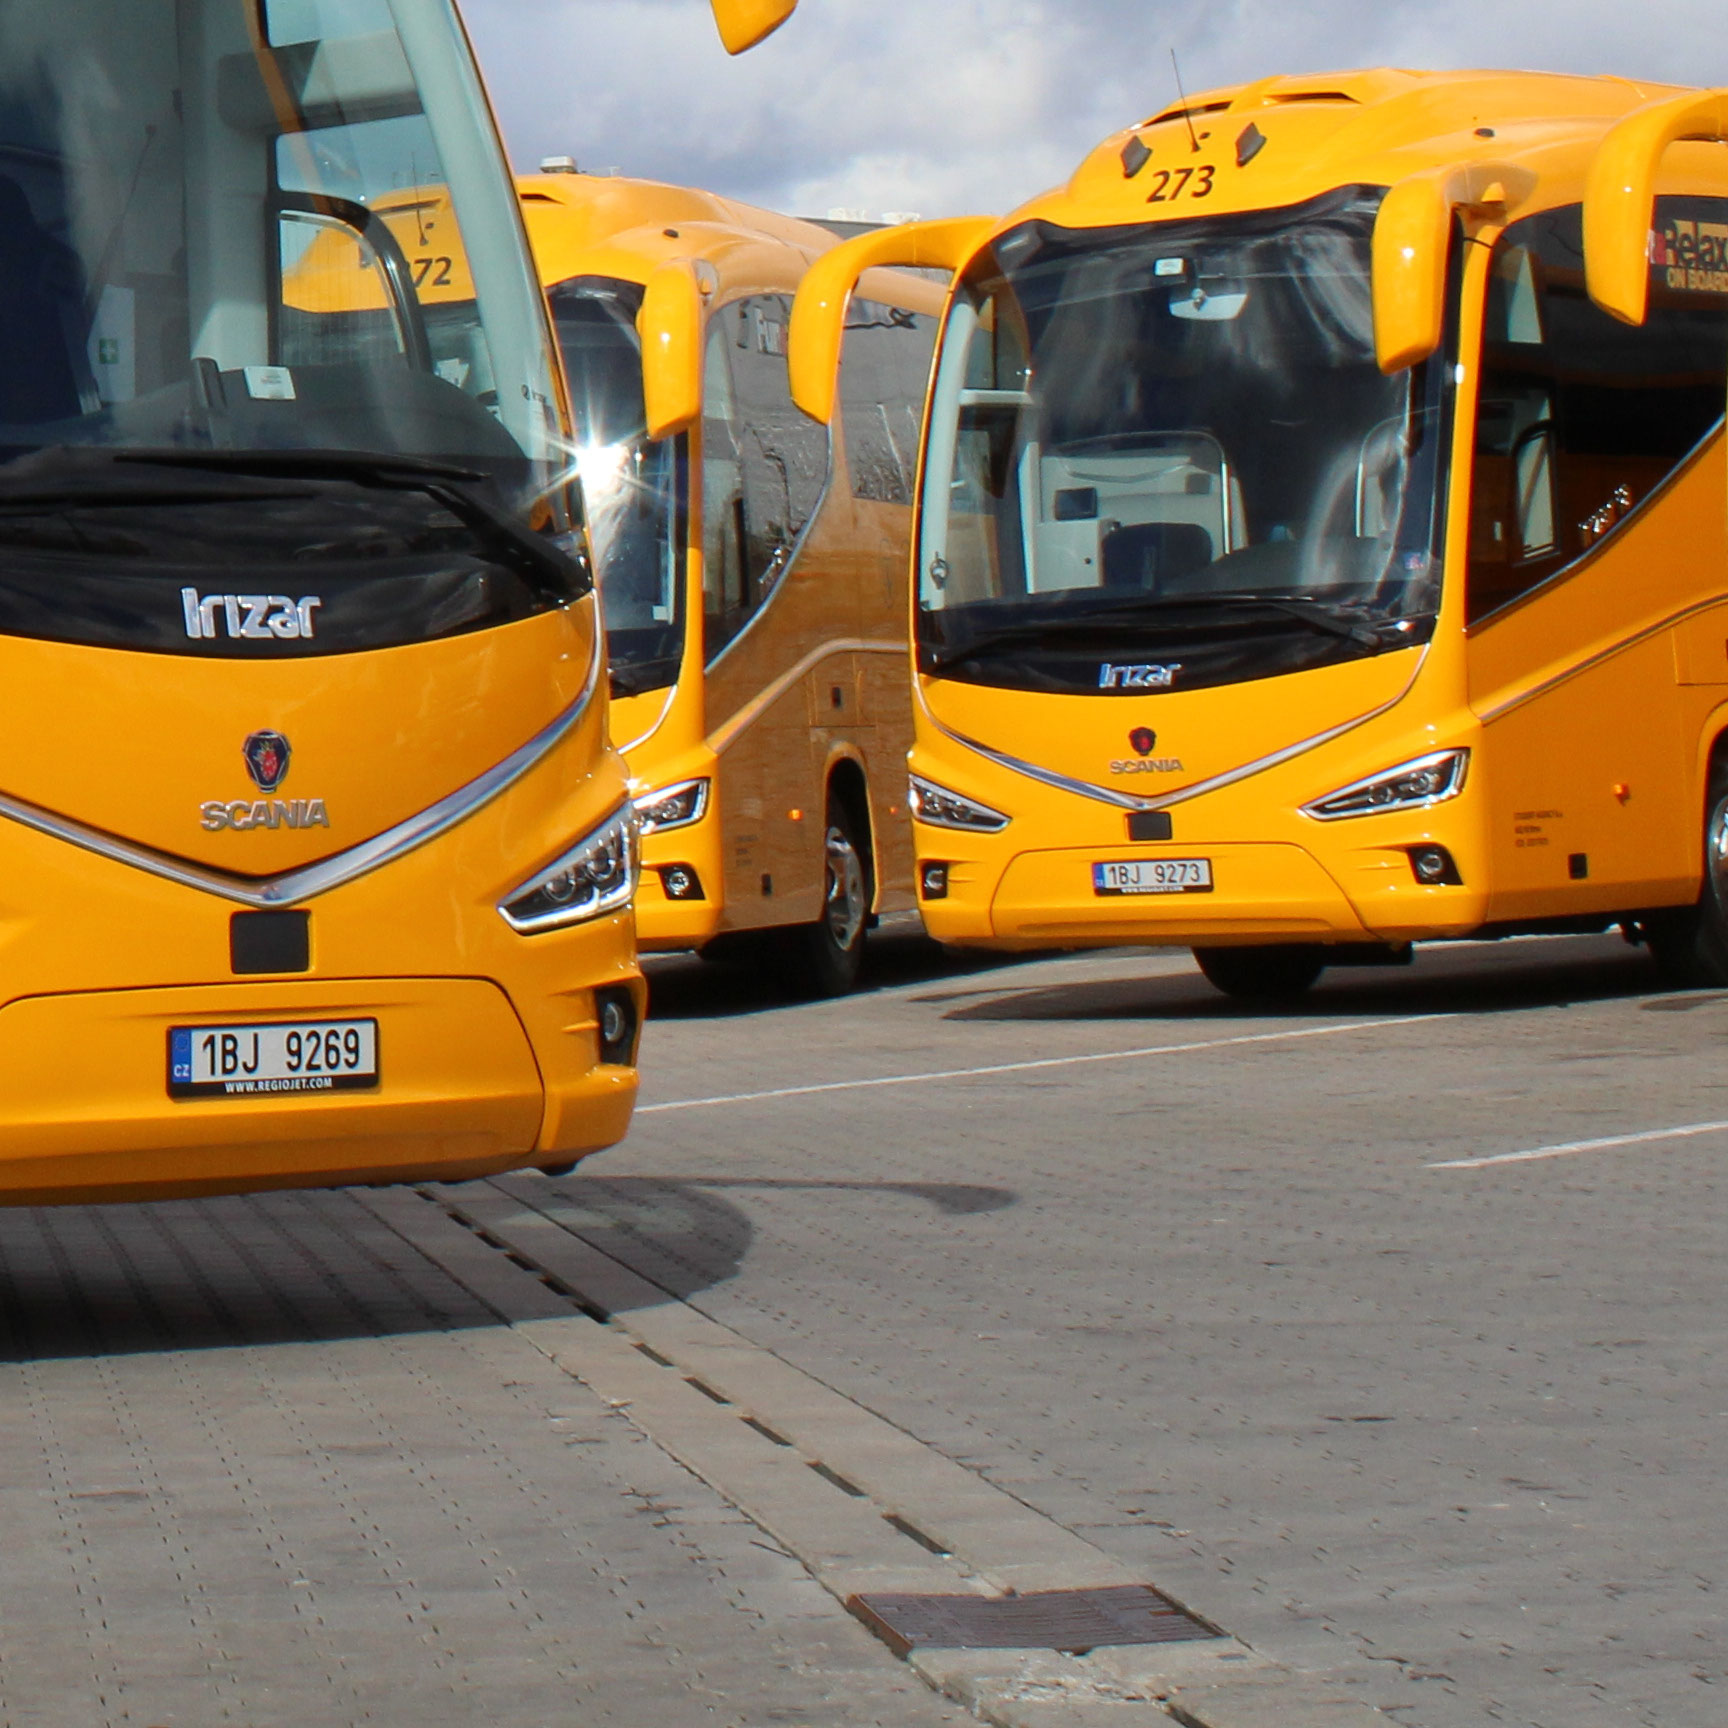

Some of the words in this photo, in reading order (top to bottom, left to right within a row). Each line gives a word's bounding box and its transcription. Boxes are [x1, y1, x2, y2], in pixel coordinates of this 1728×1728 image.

[1146, 164, 1216, 203] 273
[409, 256, 452, 287] 72
[181, 587, 322, 639] Irizar
[1110, 758, 1184, 774] SCANIA
[200, 799, 330, 831] SCANIA
[1108, 865, 1141, 885] 1BJ
[1155, 863, 1200, 883] 9273
[202, 1032, 259, 1076] 1BJ
[286, 1028, 360, 1072] 9269
[173, 1064, 190, 1078] CZ
[225, 1077, 333, 1094] WWW.REGIOJET.COM
